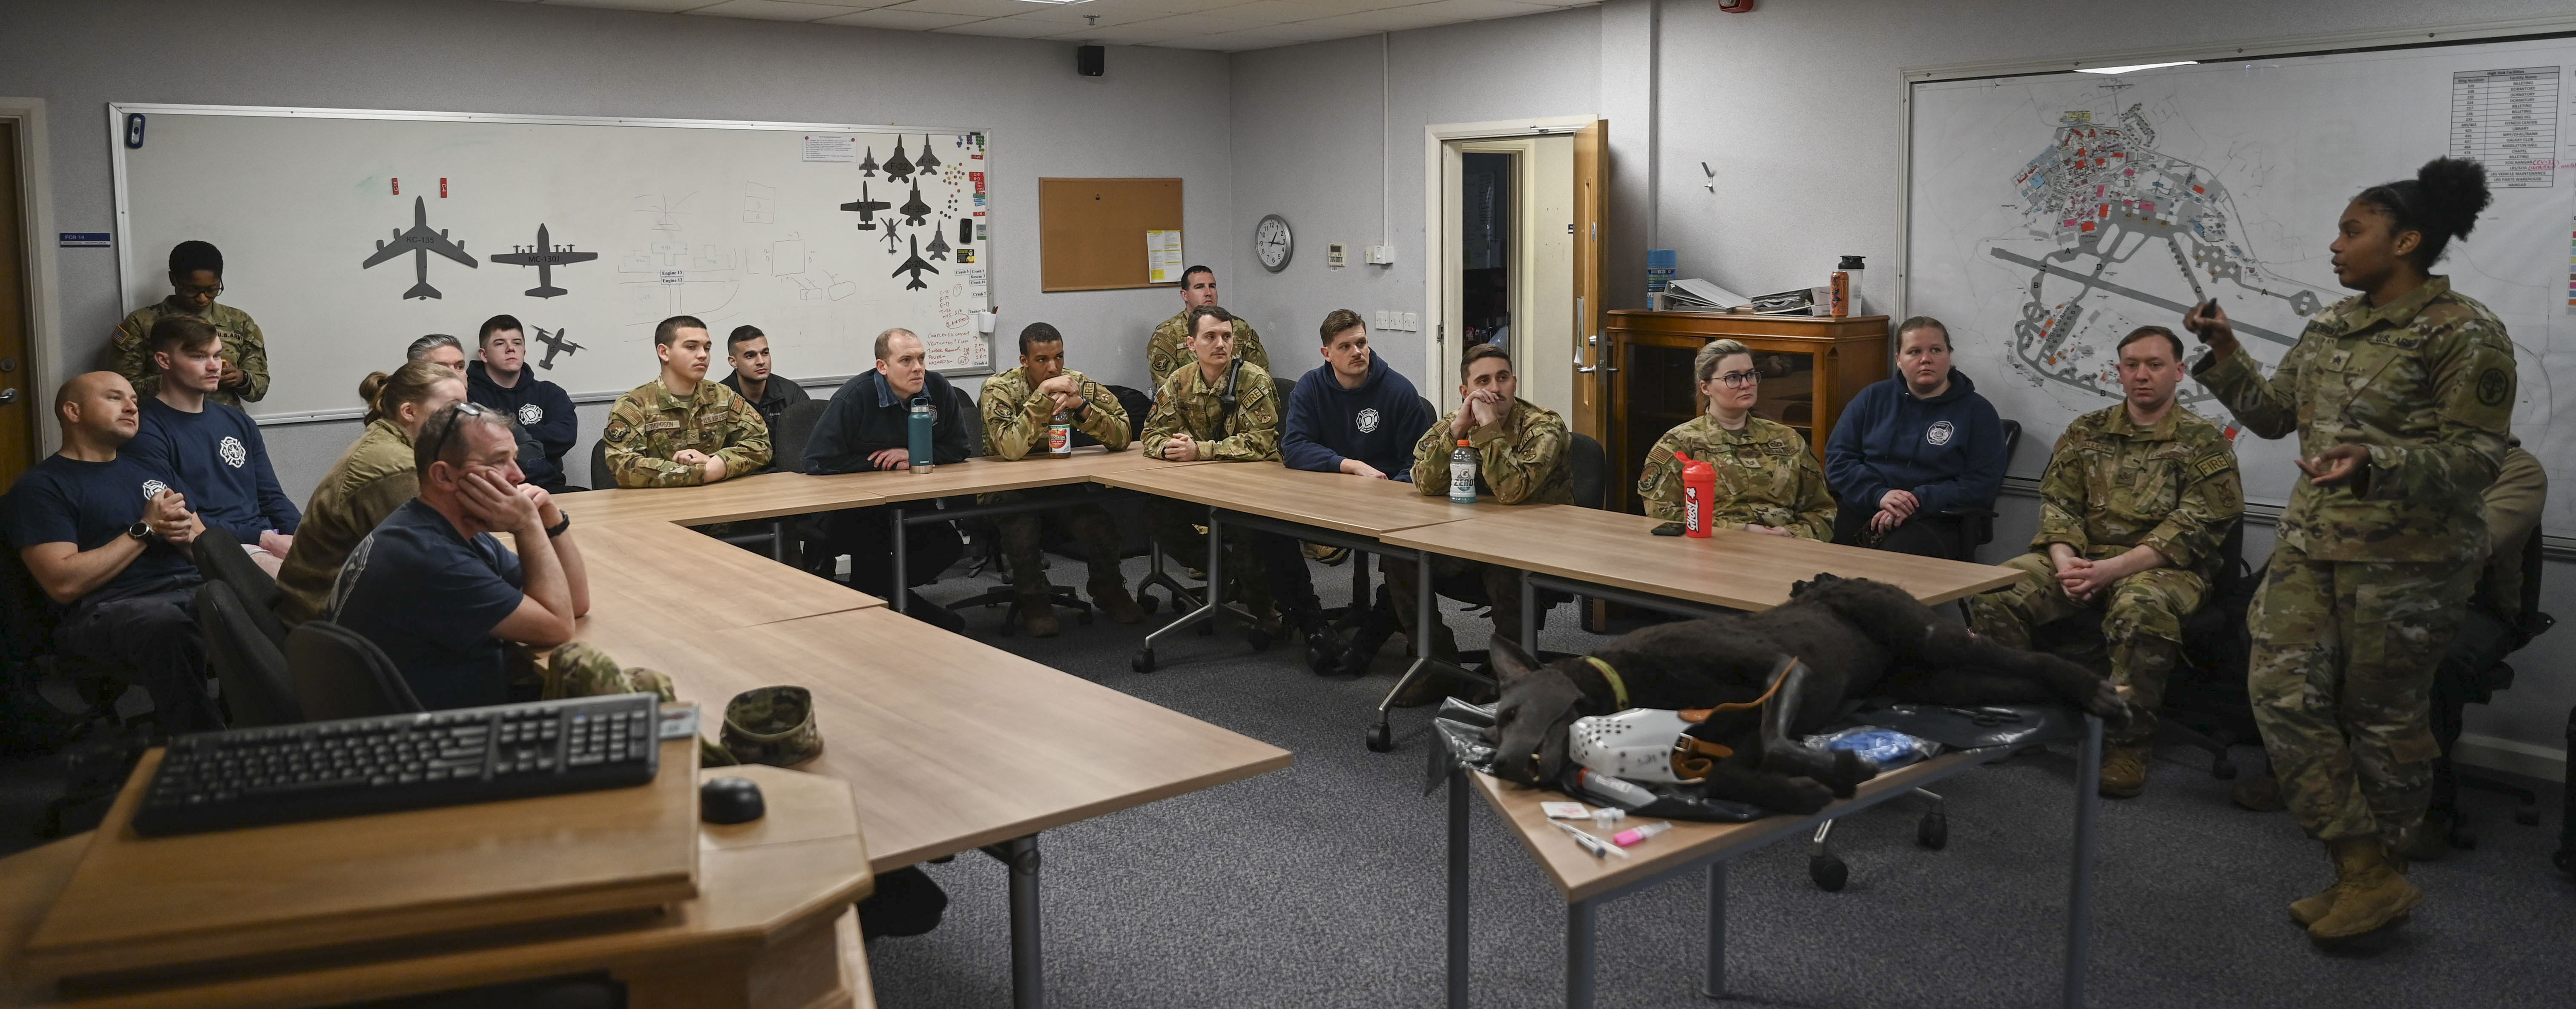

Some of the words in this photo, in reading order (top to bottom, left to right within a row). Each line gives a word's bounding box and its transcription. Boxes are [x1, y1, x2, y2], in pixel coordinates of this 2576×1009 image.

[905, 260, 924, 269] C-20
[2059, 306, 2070, 319] Ramp
[1243, 390, 1261, 407] FIRE
[650, 421, 674, 429] THOMPSON
[2199, 457, 2227, 474] FIRE
[1460, 468, 1469, 478] G
[1686, 494, 1699, 533] GHOST
